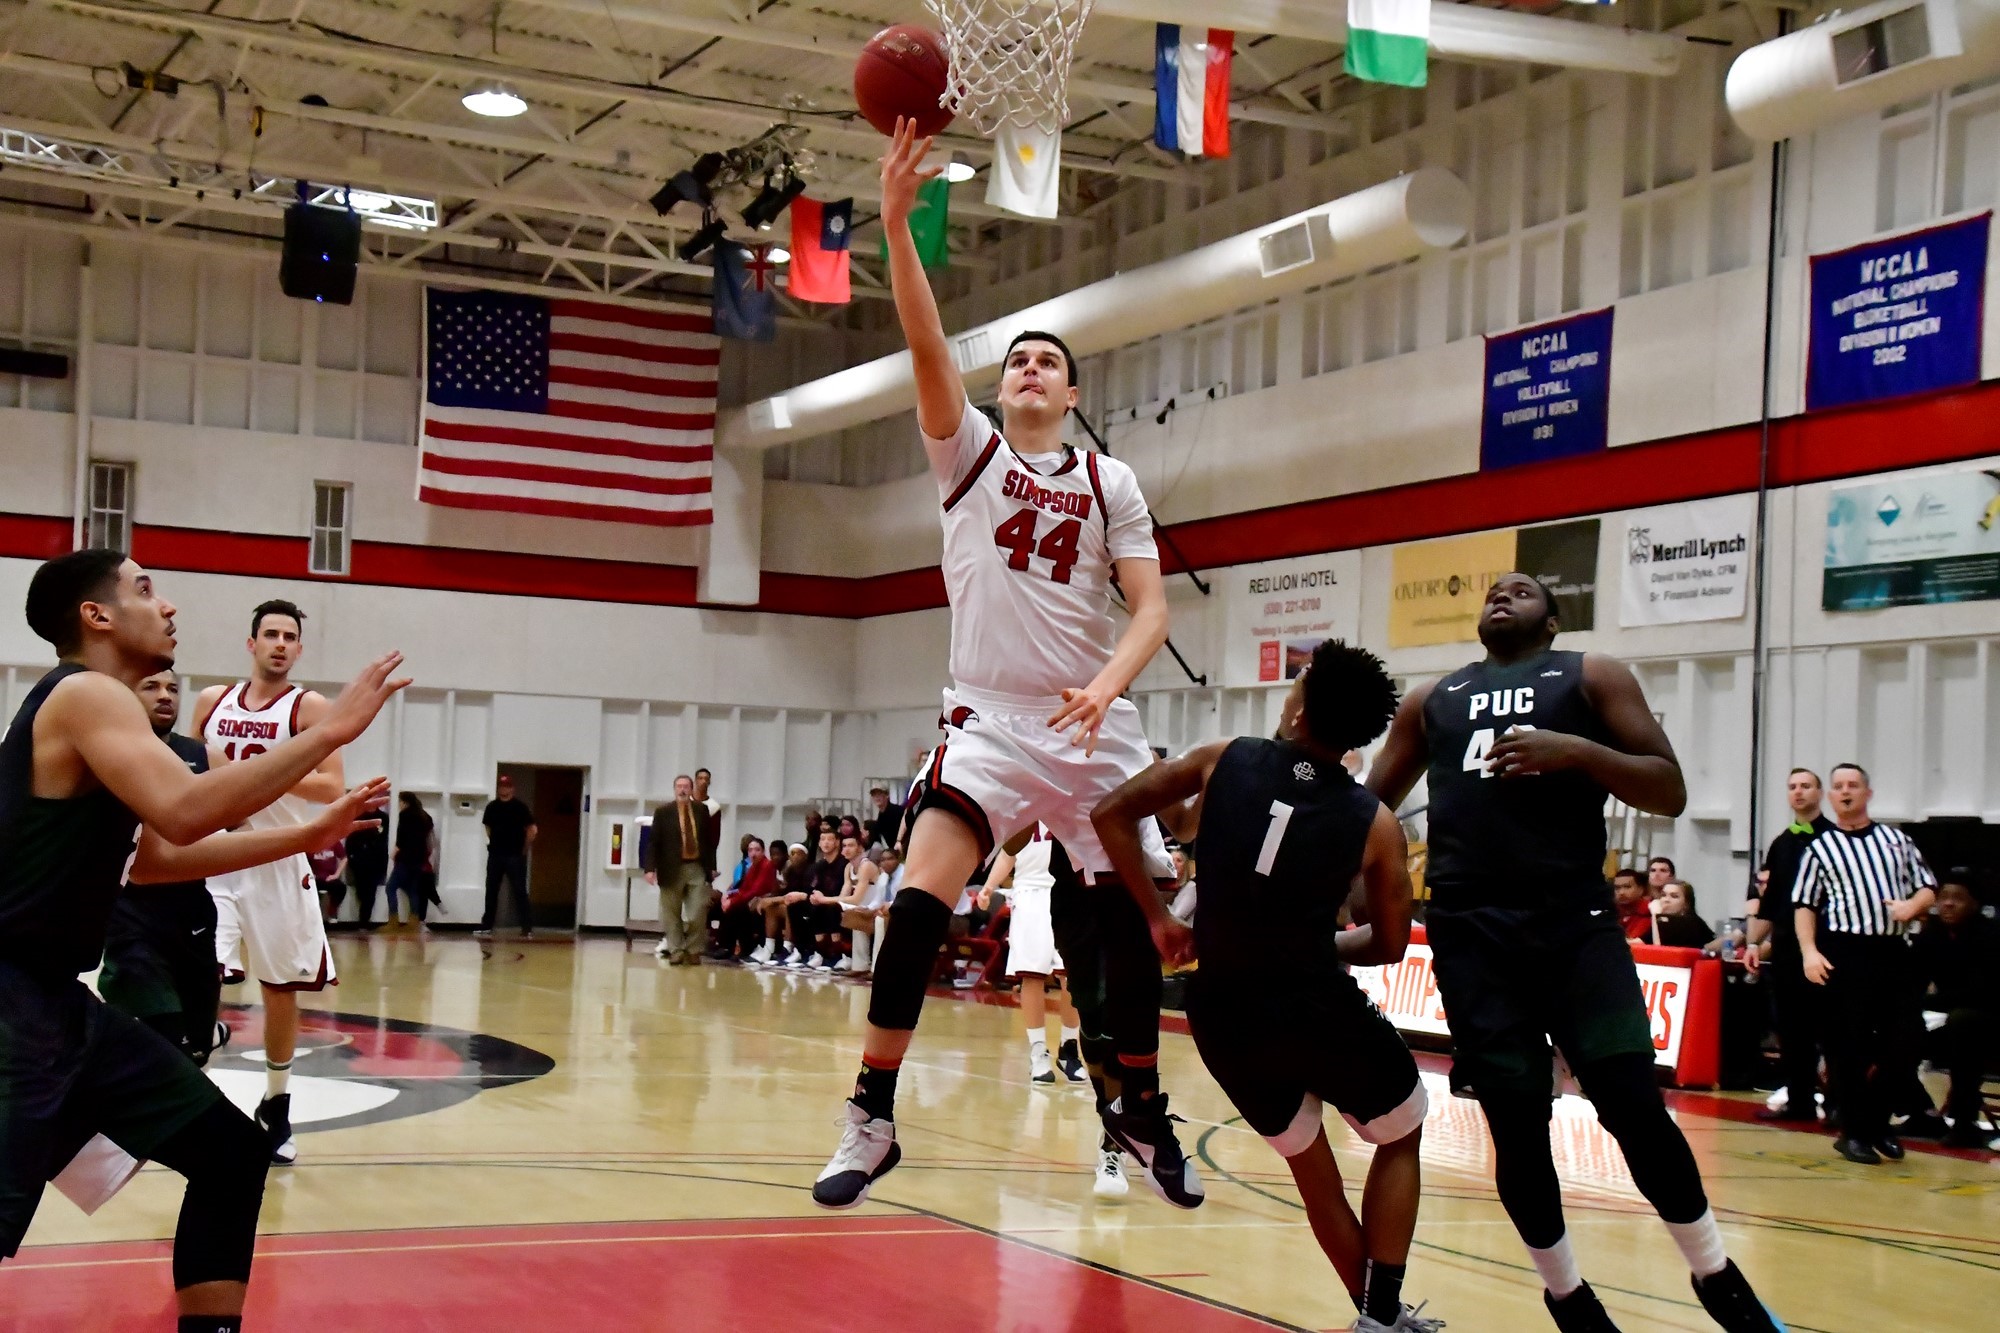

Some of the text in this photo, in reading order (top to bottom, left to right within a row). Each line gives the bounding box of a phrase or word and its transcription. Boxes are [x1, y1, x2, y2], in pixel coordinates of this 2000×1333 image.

[1861, 247, 1928, 284] NCCAA
[1521, 331, 1568, 359] NCCAA
[1002, 469, 1093, 521] SIMPSON
[994, 508, 1082, 585] 44
[1652, 533, 1746, 562] Merrill Lynch
[1249, 569, 1338, 594] RED LION HOTEL
[1469, 687, 1535, 720] PUC
[216, 718, 279, 740] SIMPSON
[1463, 724, 1541, 779] 4
[1254, 799, 1295, 877] 1
